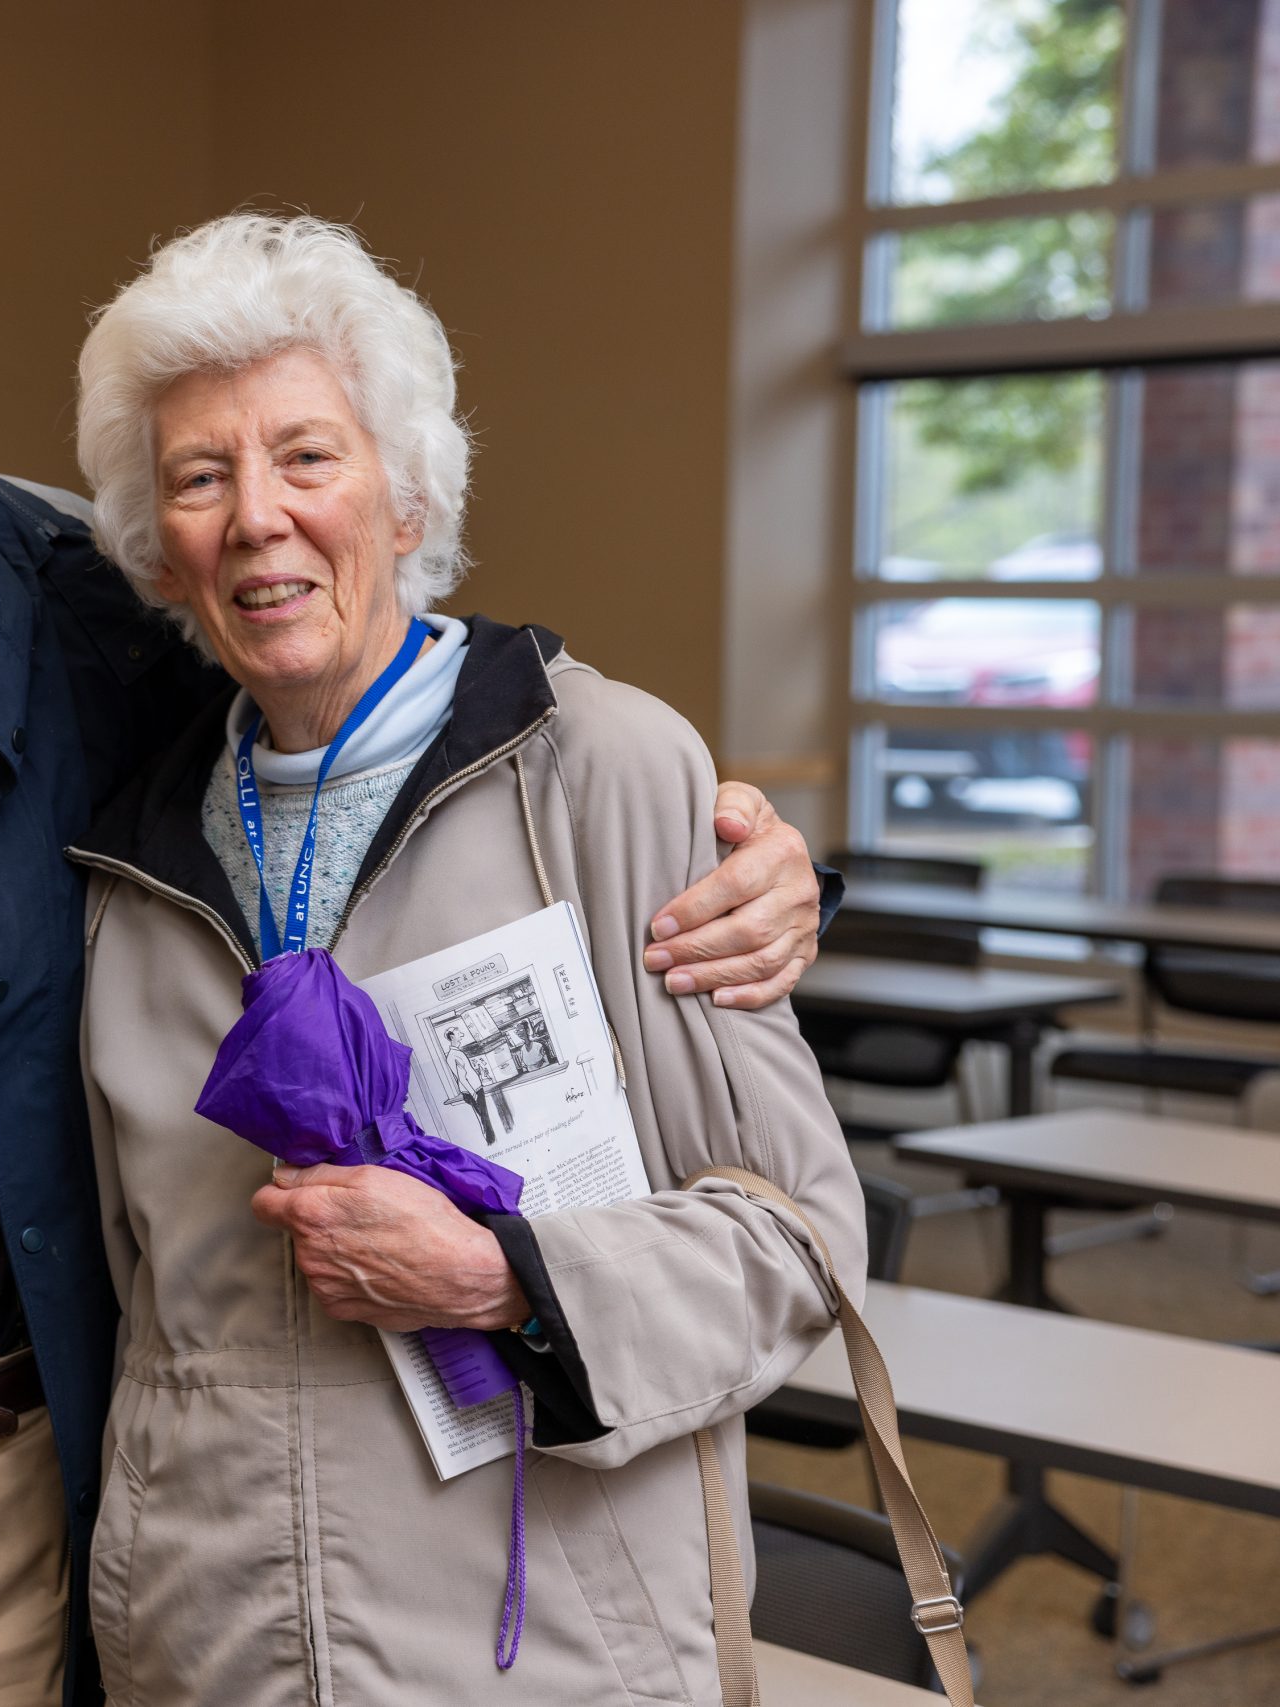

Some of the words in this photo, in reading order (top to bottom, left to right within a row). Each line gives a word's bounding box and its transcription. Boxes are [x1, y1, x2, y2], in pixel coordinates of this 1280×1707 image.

[239, 756, 256, 807] OLLI
[247, 820, 258, 838] at
[296, 847, 313, 895] UNC
[295, 902, 305, 921] at
[440, 976, 462, 990] LOST
